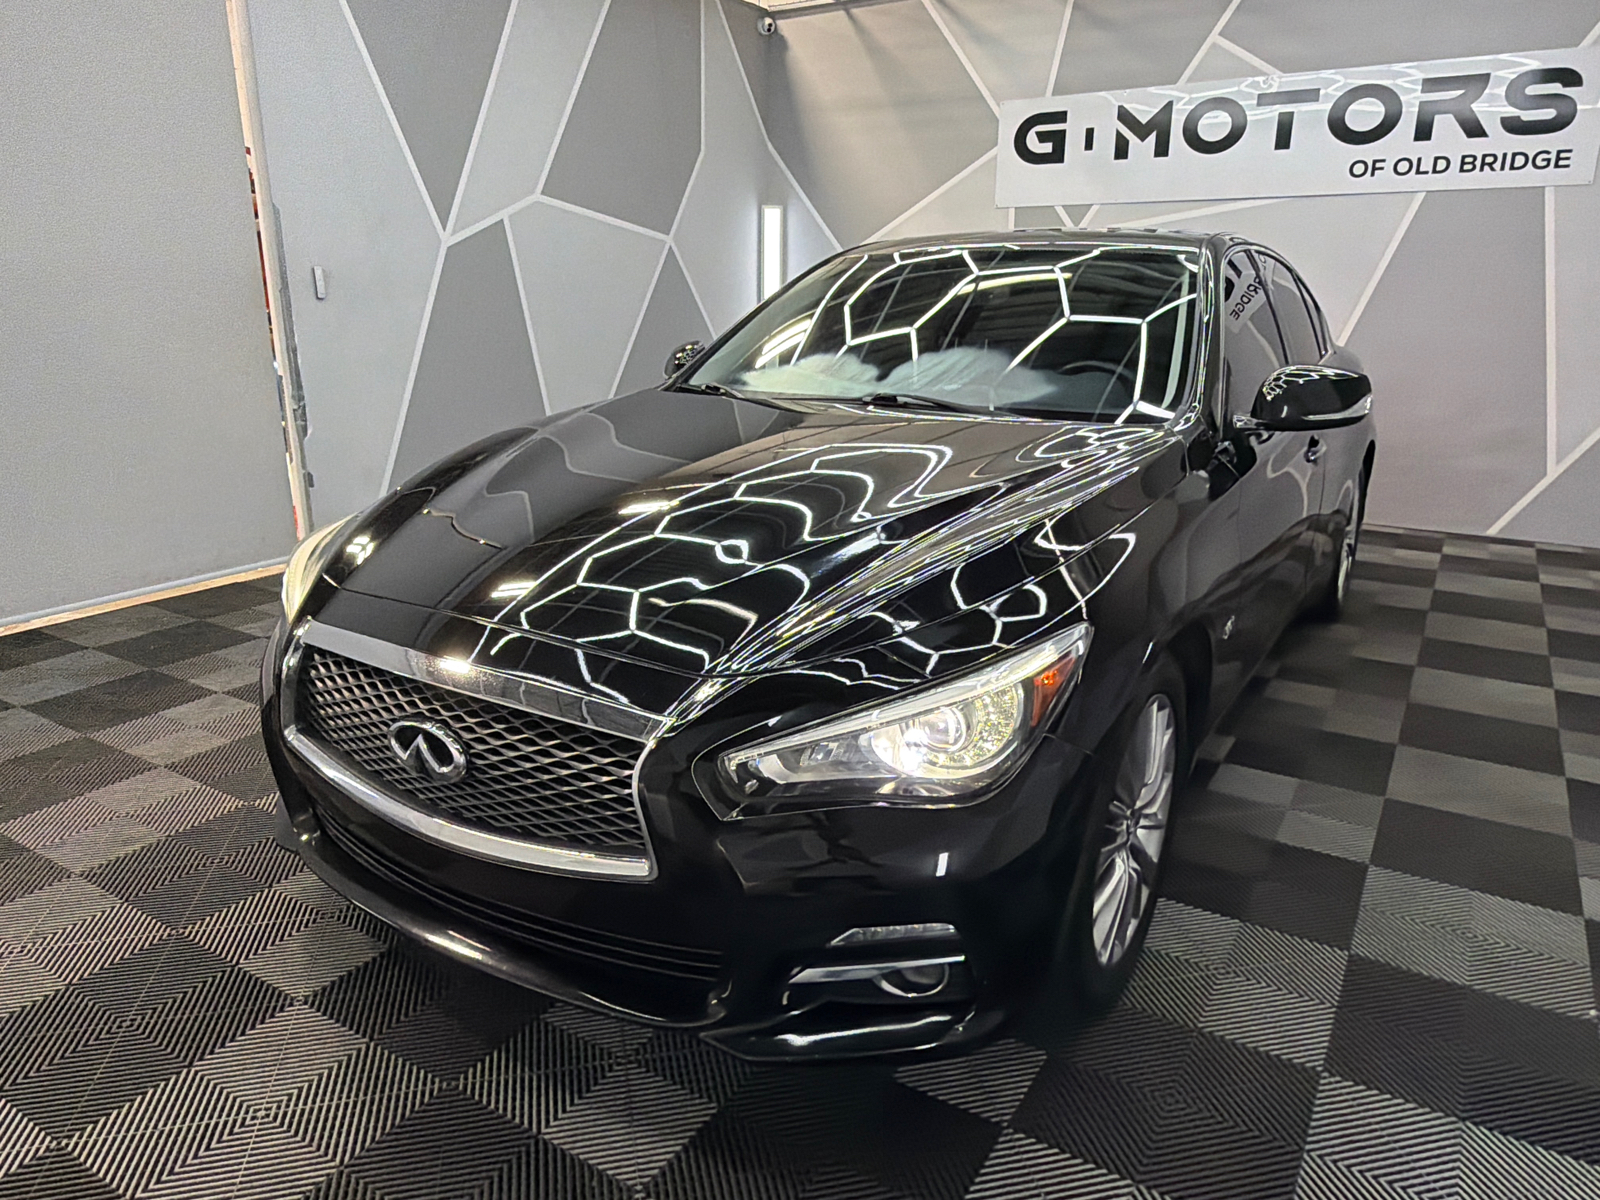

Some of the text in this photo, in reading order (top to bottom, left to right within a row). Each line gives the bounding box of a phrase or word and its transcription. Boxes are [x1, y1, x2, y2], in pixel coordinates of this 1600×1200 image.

[1349, 148, 1574, 179] OF OLD BRIDGE
